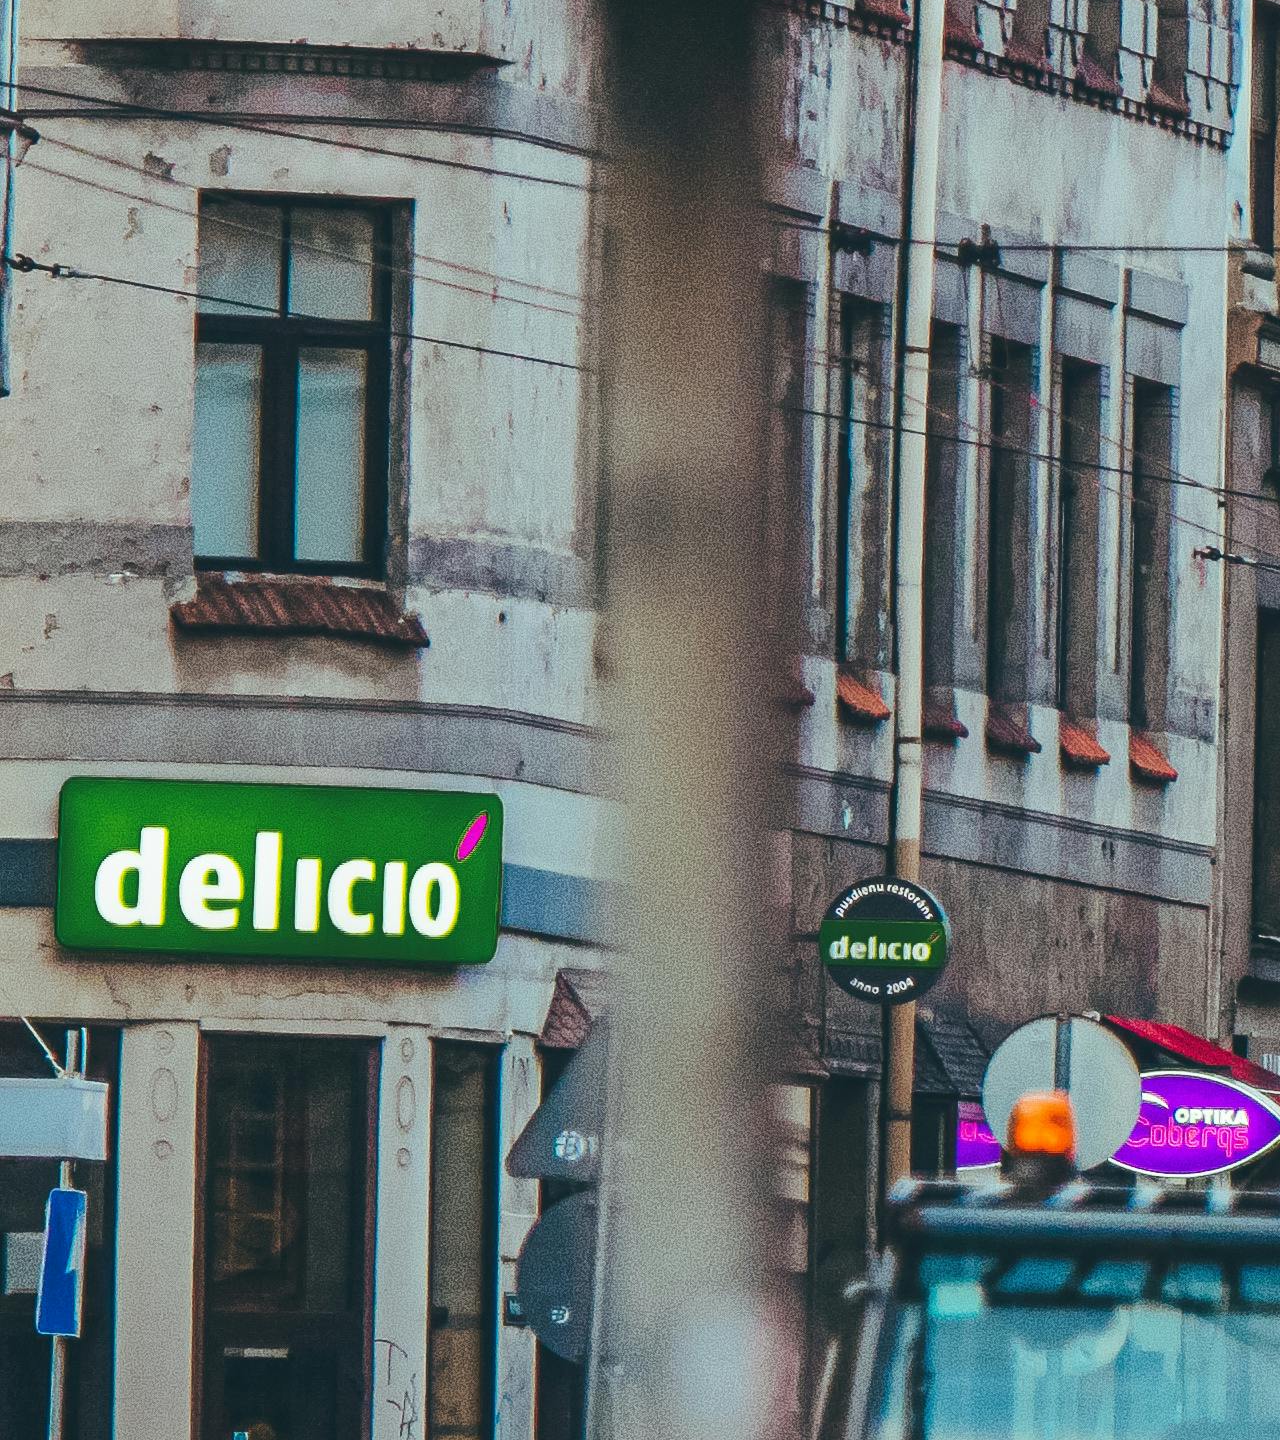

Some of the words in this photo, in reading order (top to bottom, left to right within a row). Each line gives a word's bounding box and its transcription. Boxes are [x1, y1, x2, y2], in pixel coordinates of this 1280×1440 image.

[835, 883, 885, 918] pusdienu
[849, 977, 880, 995] anno
[886, 976, 915, 995] 2004
[1174, 1107, 1249, 1126] OPTIKA
